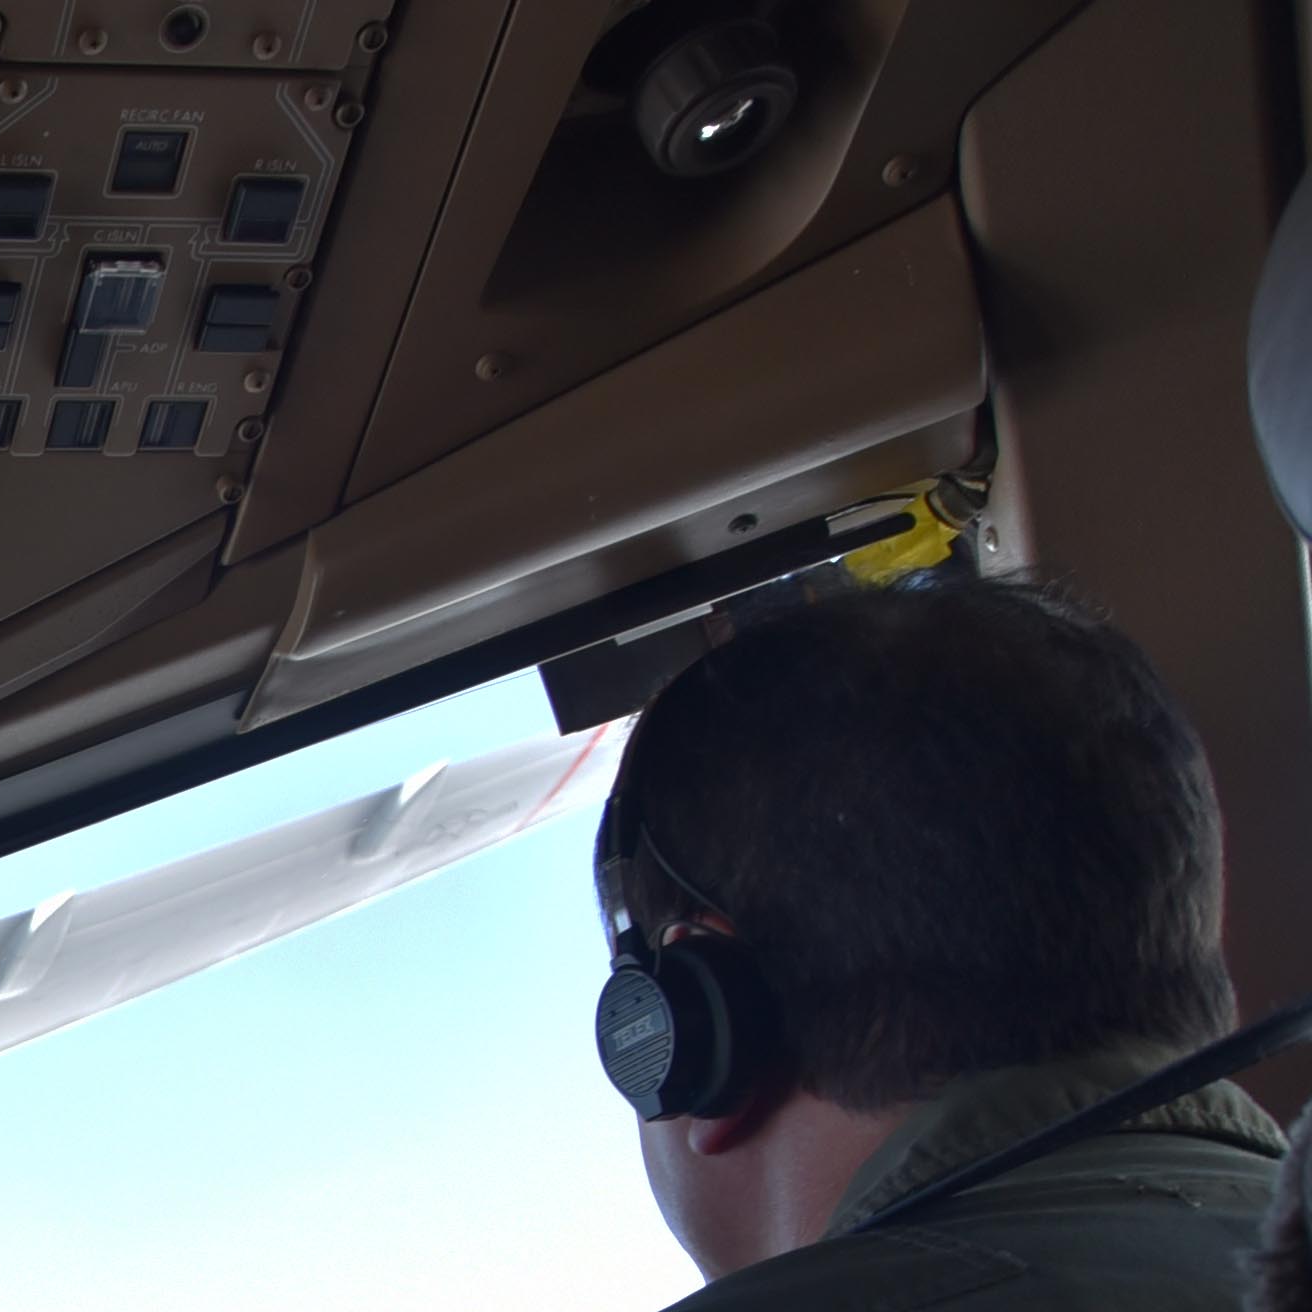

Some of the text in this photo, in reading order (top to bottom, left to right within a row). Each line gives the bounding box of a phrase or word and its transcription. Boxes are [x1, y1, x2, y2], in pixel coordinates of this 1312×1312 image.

[176, 109, 207, 124] FAN
[12, 154, 44, 168] ISLN
[267, 159, 297, 172] ISLN
[107, 230, 138, 243] ISLN
